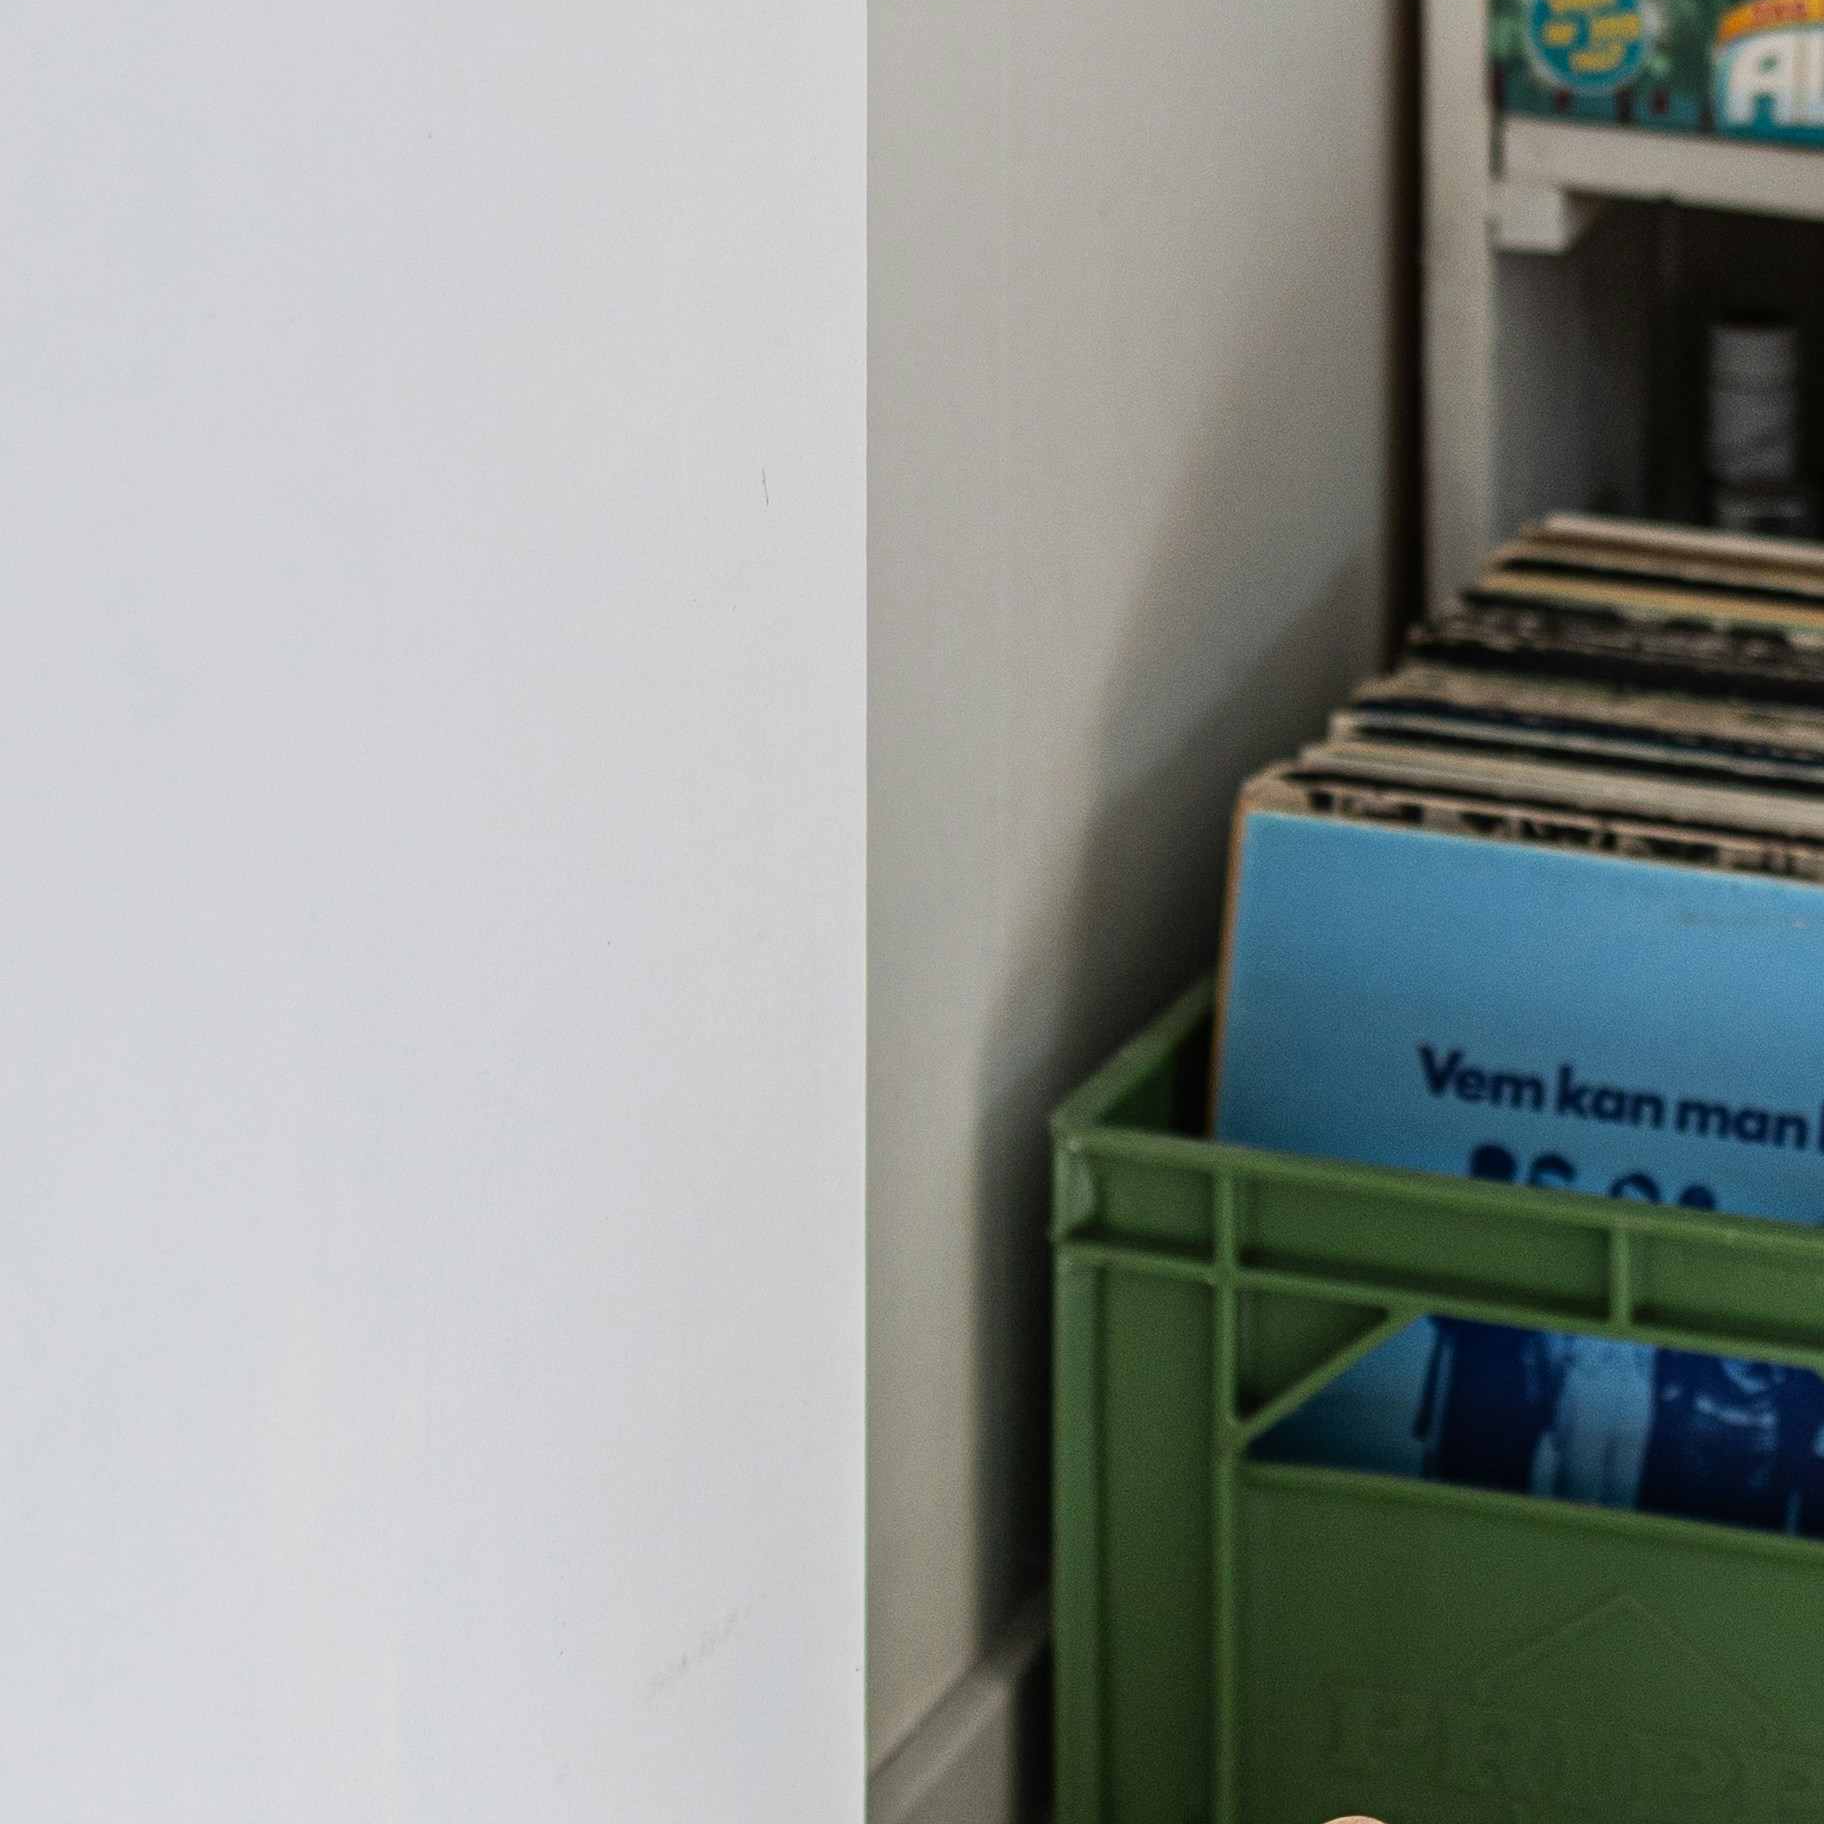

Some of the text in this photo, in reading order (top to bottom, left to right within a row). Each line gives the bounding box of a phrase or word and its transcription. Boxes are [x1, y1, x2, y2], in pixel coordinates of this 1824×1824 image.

[1418, 1043, 1546, 1114] Vem
[1554, 1063, 1667, 1132] kan
[1675, 1097, 1809, 1152] man
